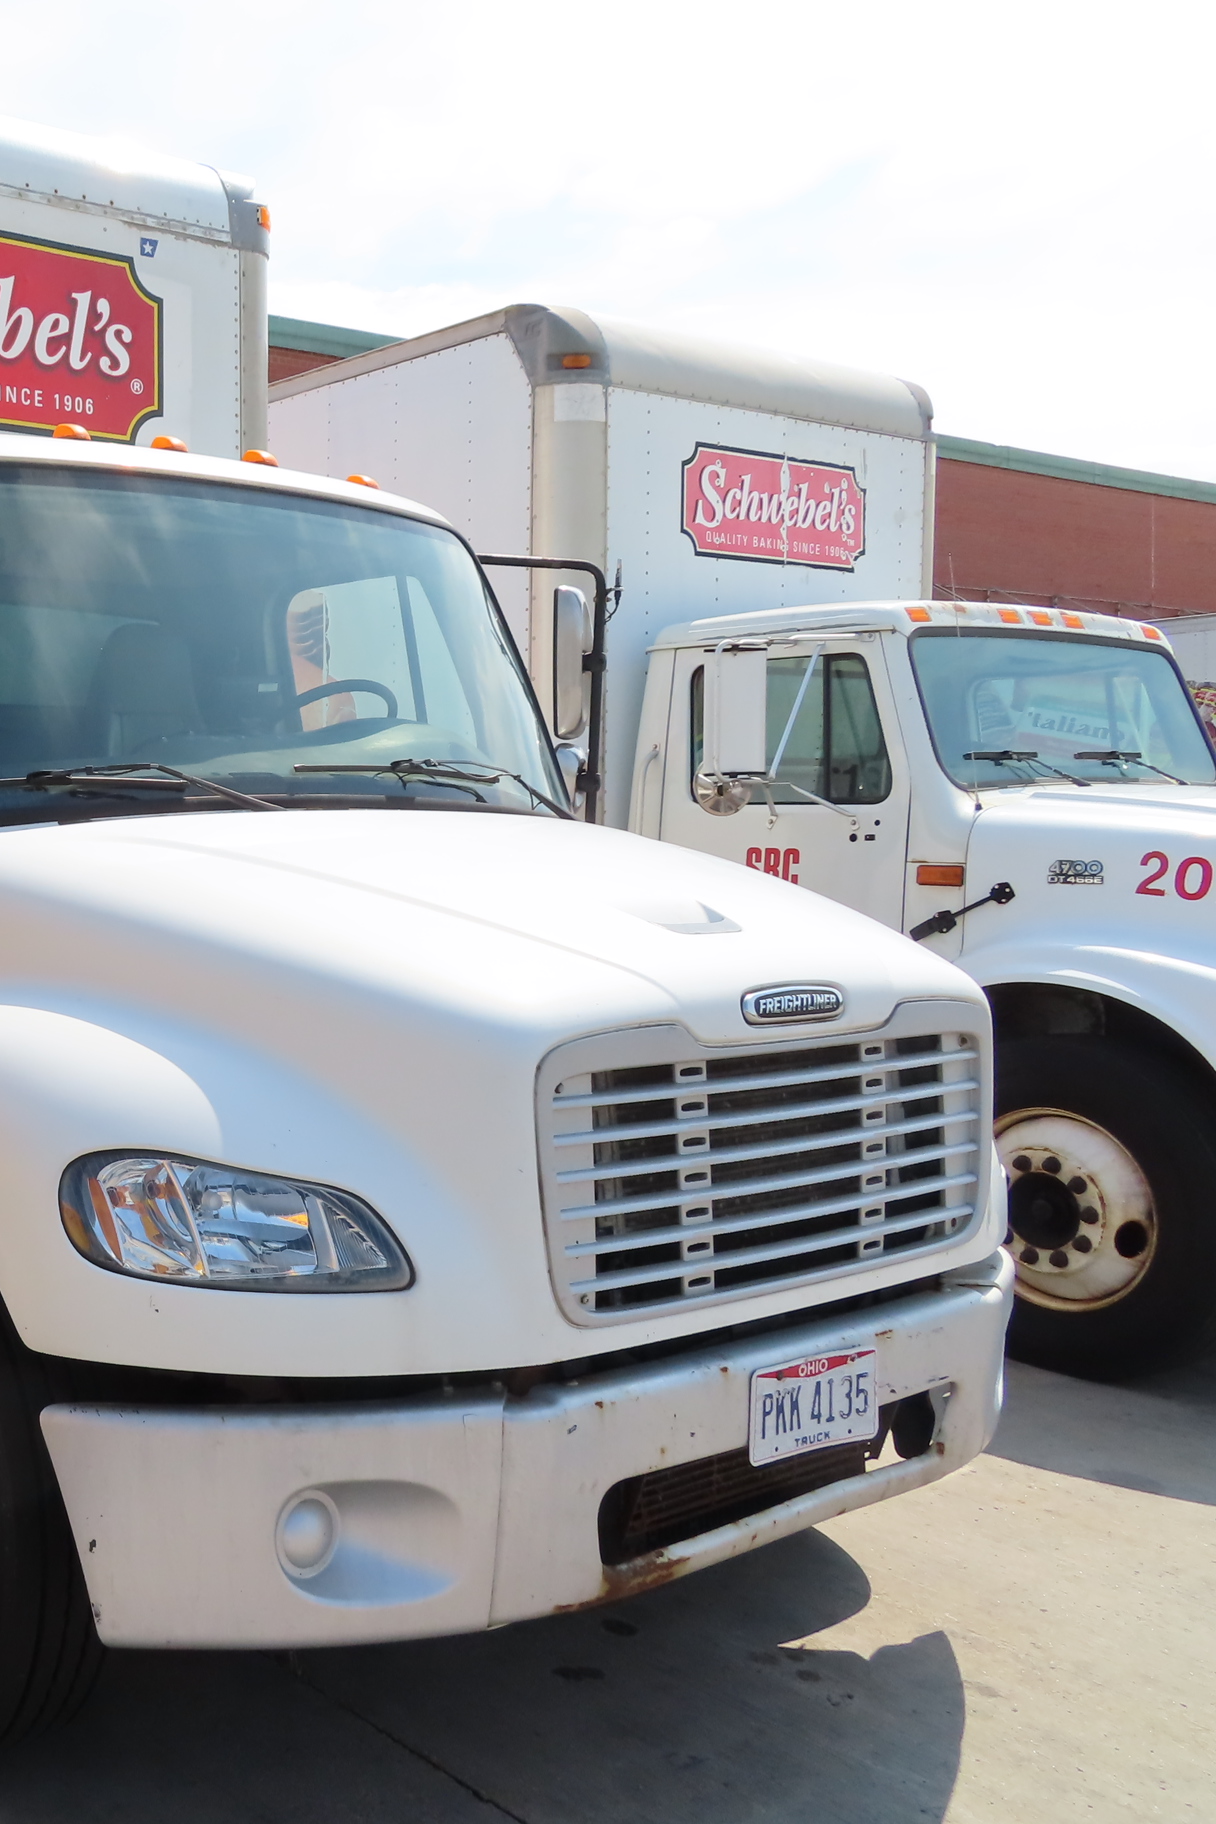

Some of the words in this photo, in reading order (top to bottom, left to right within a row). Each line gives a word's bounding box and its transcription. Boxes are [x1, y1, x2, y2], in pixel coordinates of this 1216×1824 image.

[53, 393, 95, 415] 1906
[695, 464, 857, 534] Schwebel's
[705, 530, 748, 547] QUALITY
[752, 537, 789, 552] BAKING
[792, 541, 821, 555] SINCE
[1048, 860, 1104, 875] 4700
[1135, 850, 1214, 901] 20
[759, 993, 837, 1014] FREIGHTLINER
[798, 1358, 828, 1377] OHIO
[761, 1385, 802, 1439] PKK
[810, 1371, 869, 1424] 4135
[794, 1431, 831, 1448] TRUCK
